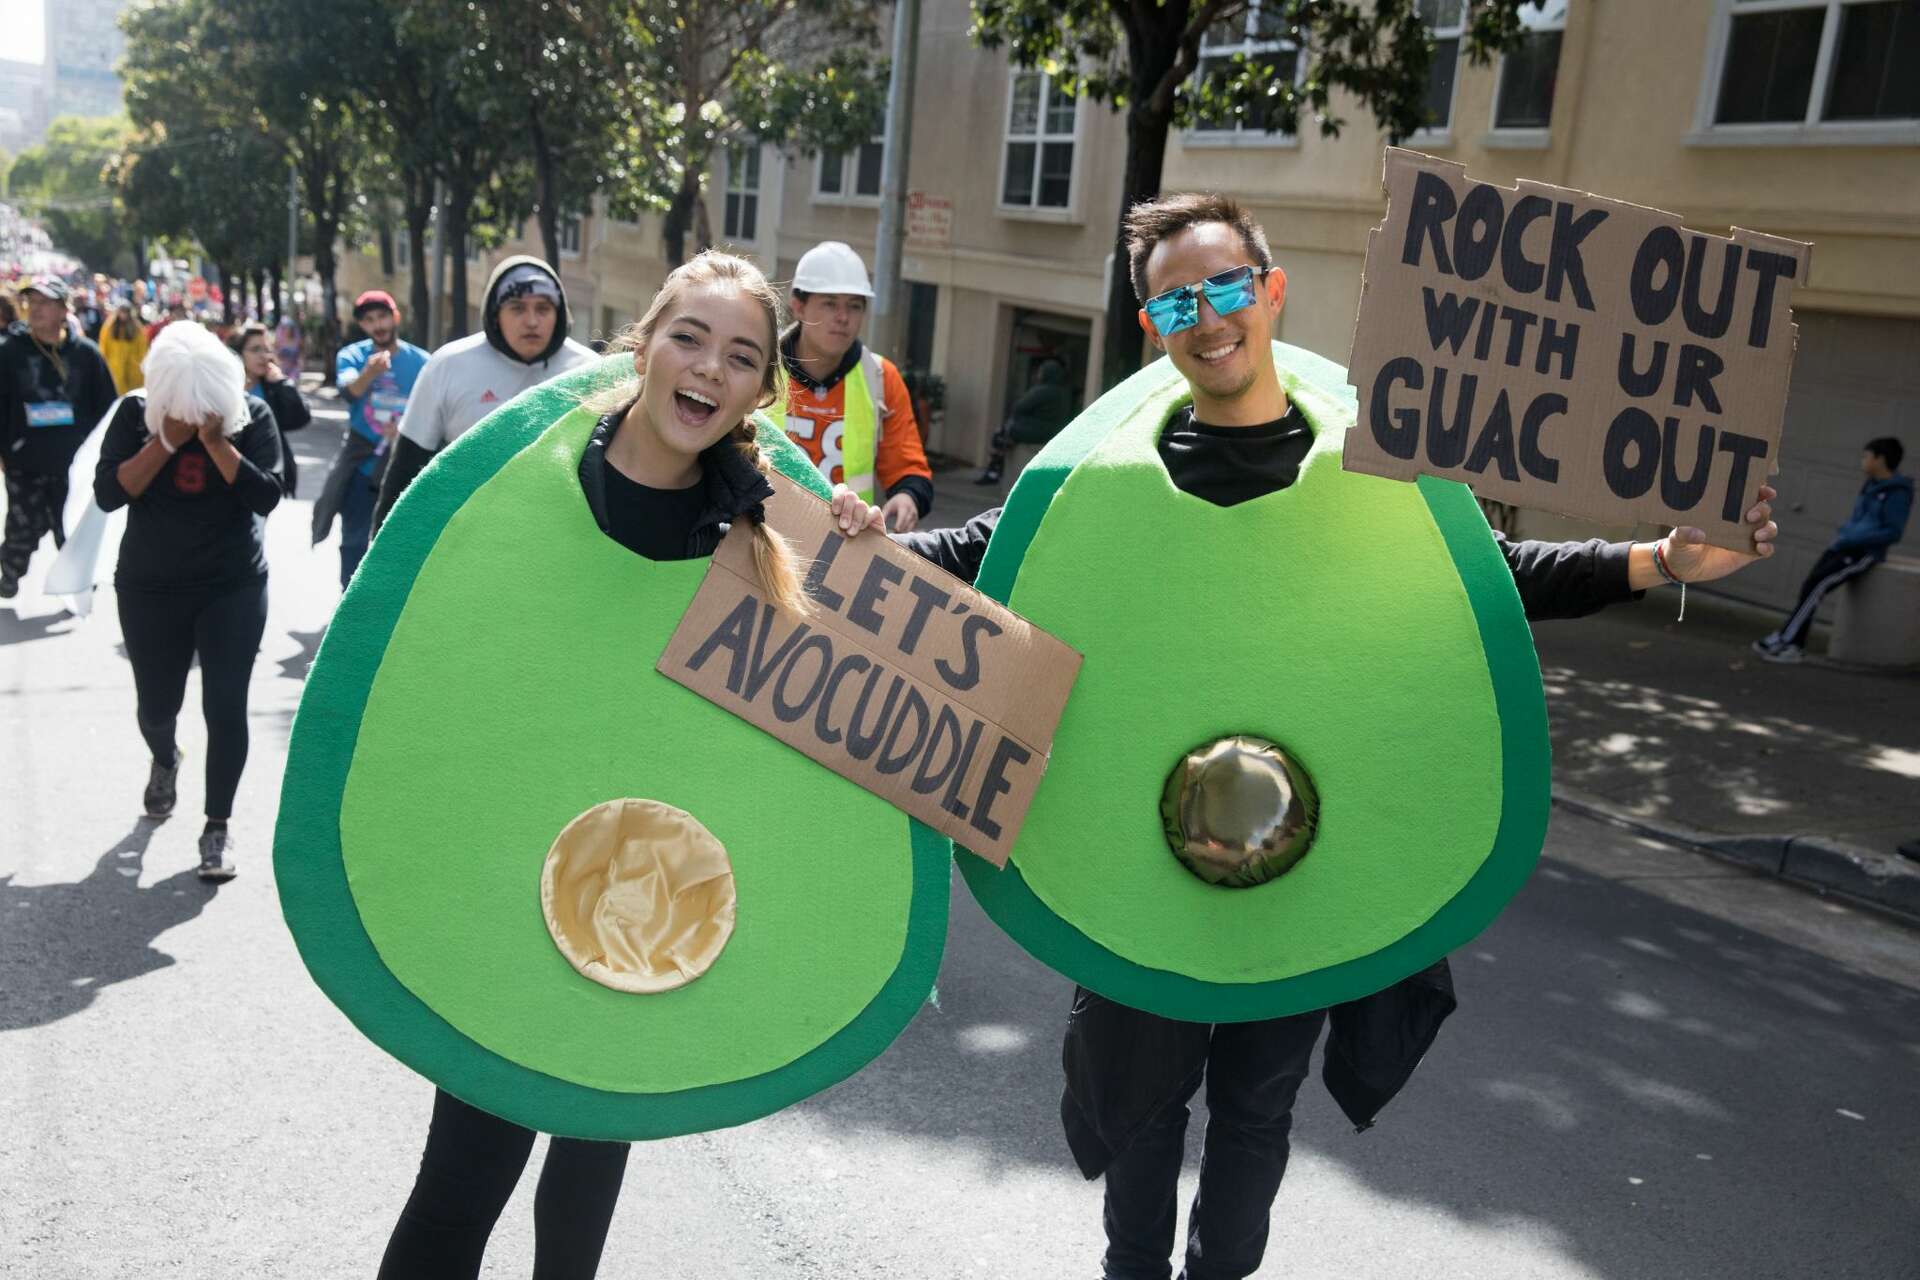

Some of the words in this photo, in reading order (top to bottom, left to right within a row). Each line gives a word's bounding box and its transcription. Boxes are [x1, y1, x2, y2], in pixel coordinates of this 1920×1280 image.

[1402, 170, 1609, 312] ROCK
[1630, 226, 1797, 349] OUT
[1423, 286, 1580, 380] WITH
[1618, 332, 1724, 414] UR
[1370, 356, 1568, 484] GUAC
[1603, 407, 1768, 524] OUT
[803, 530, 1003, 691] LET'S
[686, 594, 1031, 842] AVOCUDDLE
